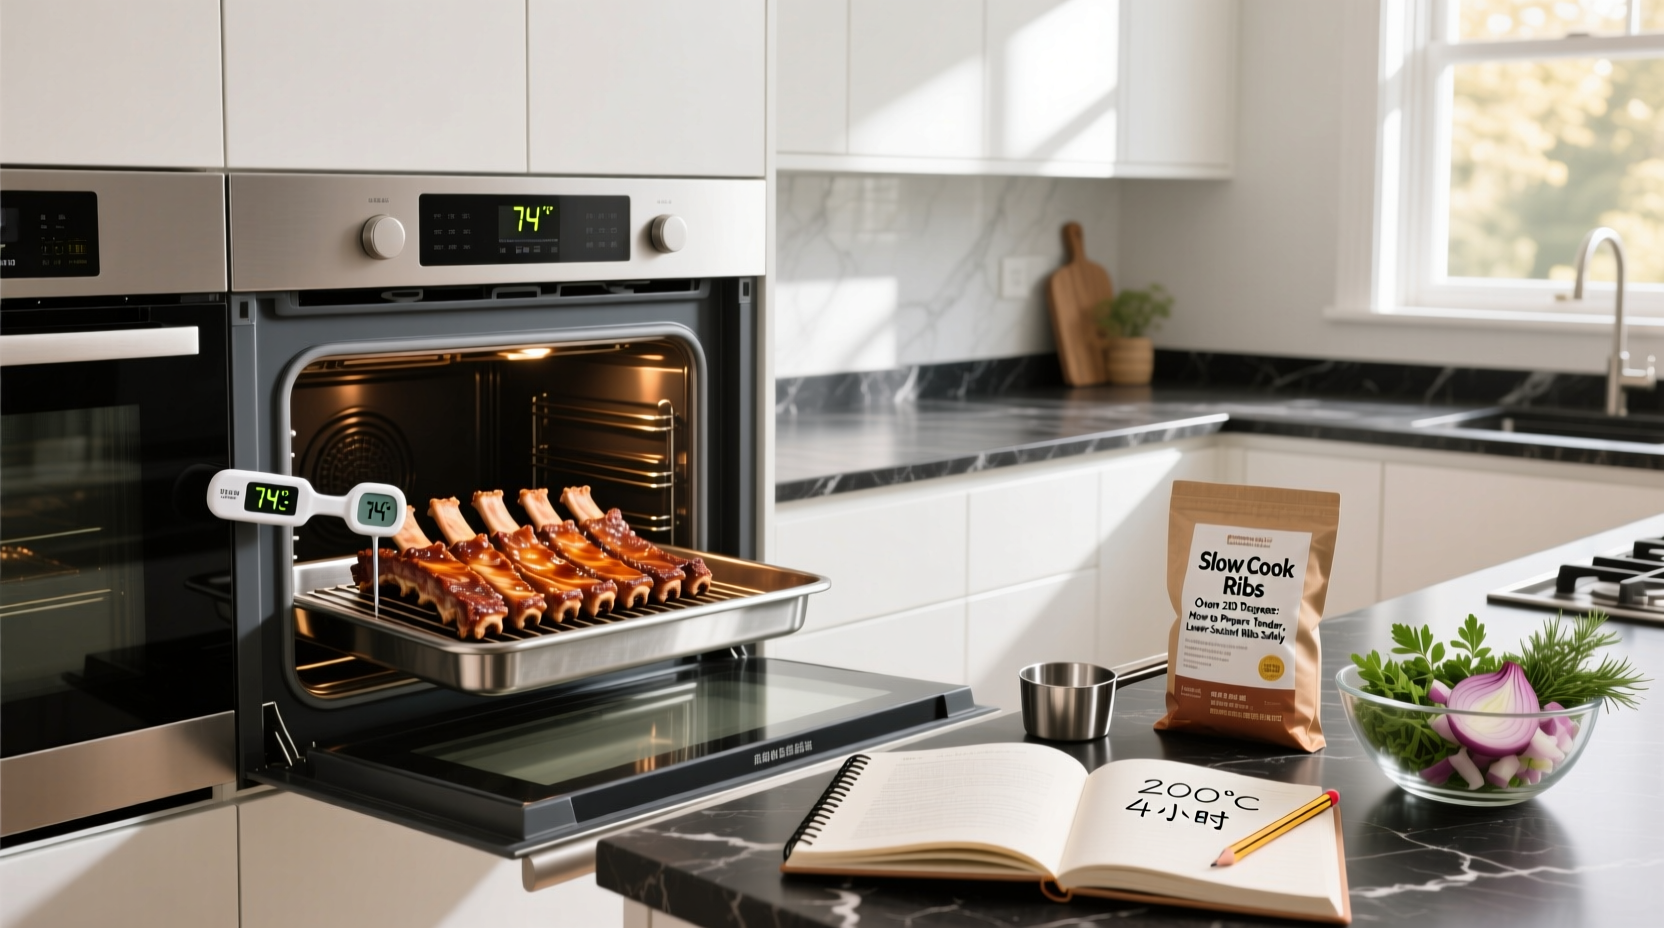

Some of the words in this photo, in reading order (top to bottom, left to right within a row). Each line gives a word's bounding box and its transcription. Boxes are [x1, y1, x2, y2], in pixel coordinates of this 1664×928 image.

[1198, 551, 1245, 574] Slow
[1247, 556, 1295, 578] Cook
[1223, 576, 1265, 598] Ribs
[1138, 779, 1260, 811] 200°C
[1125, 798, 1230, 831] 4小时
